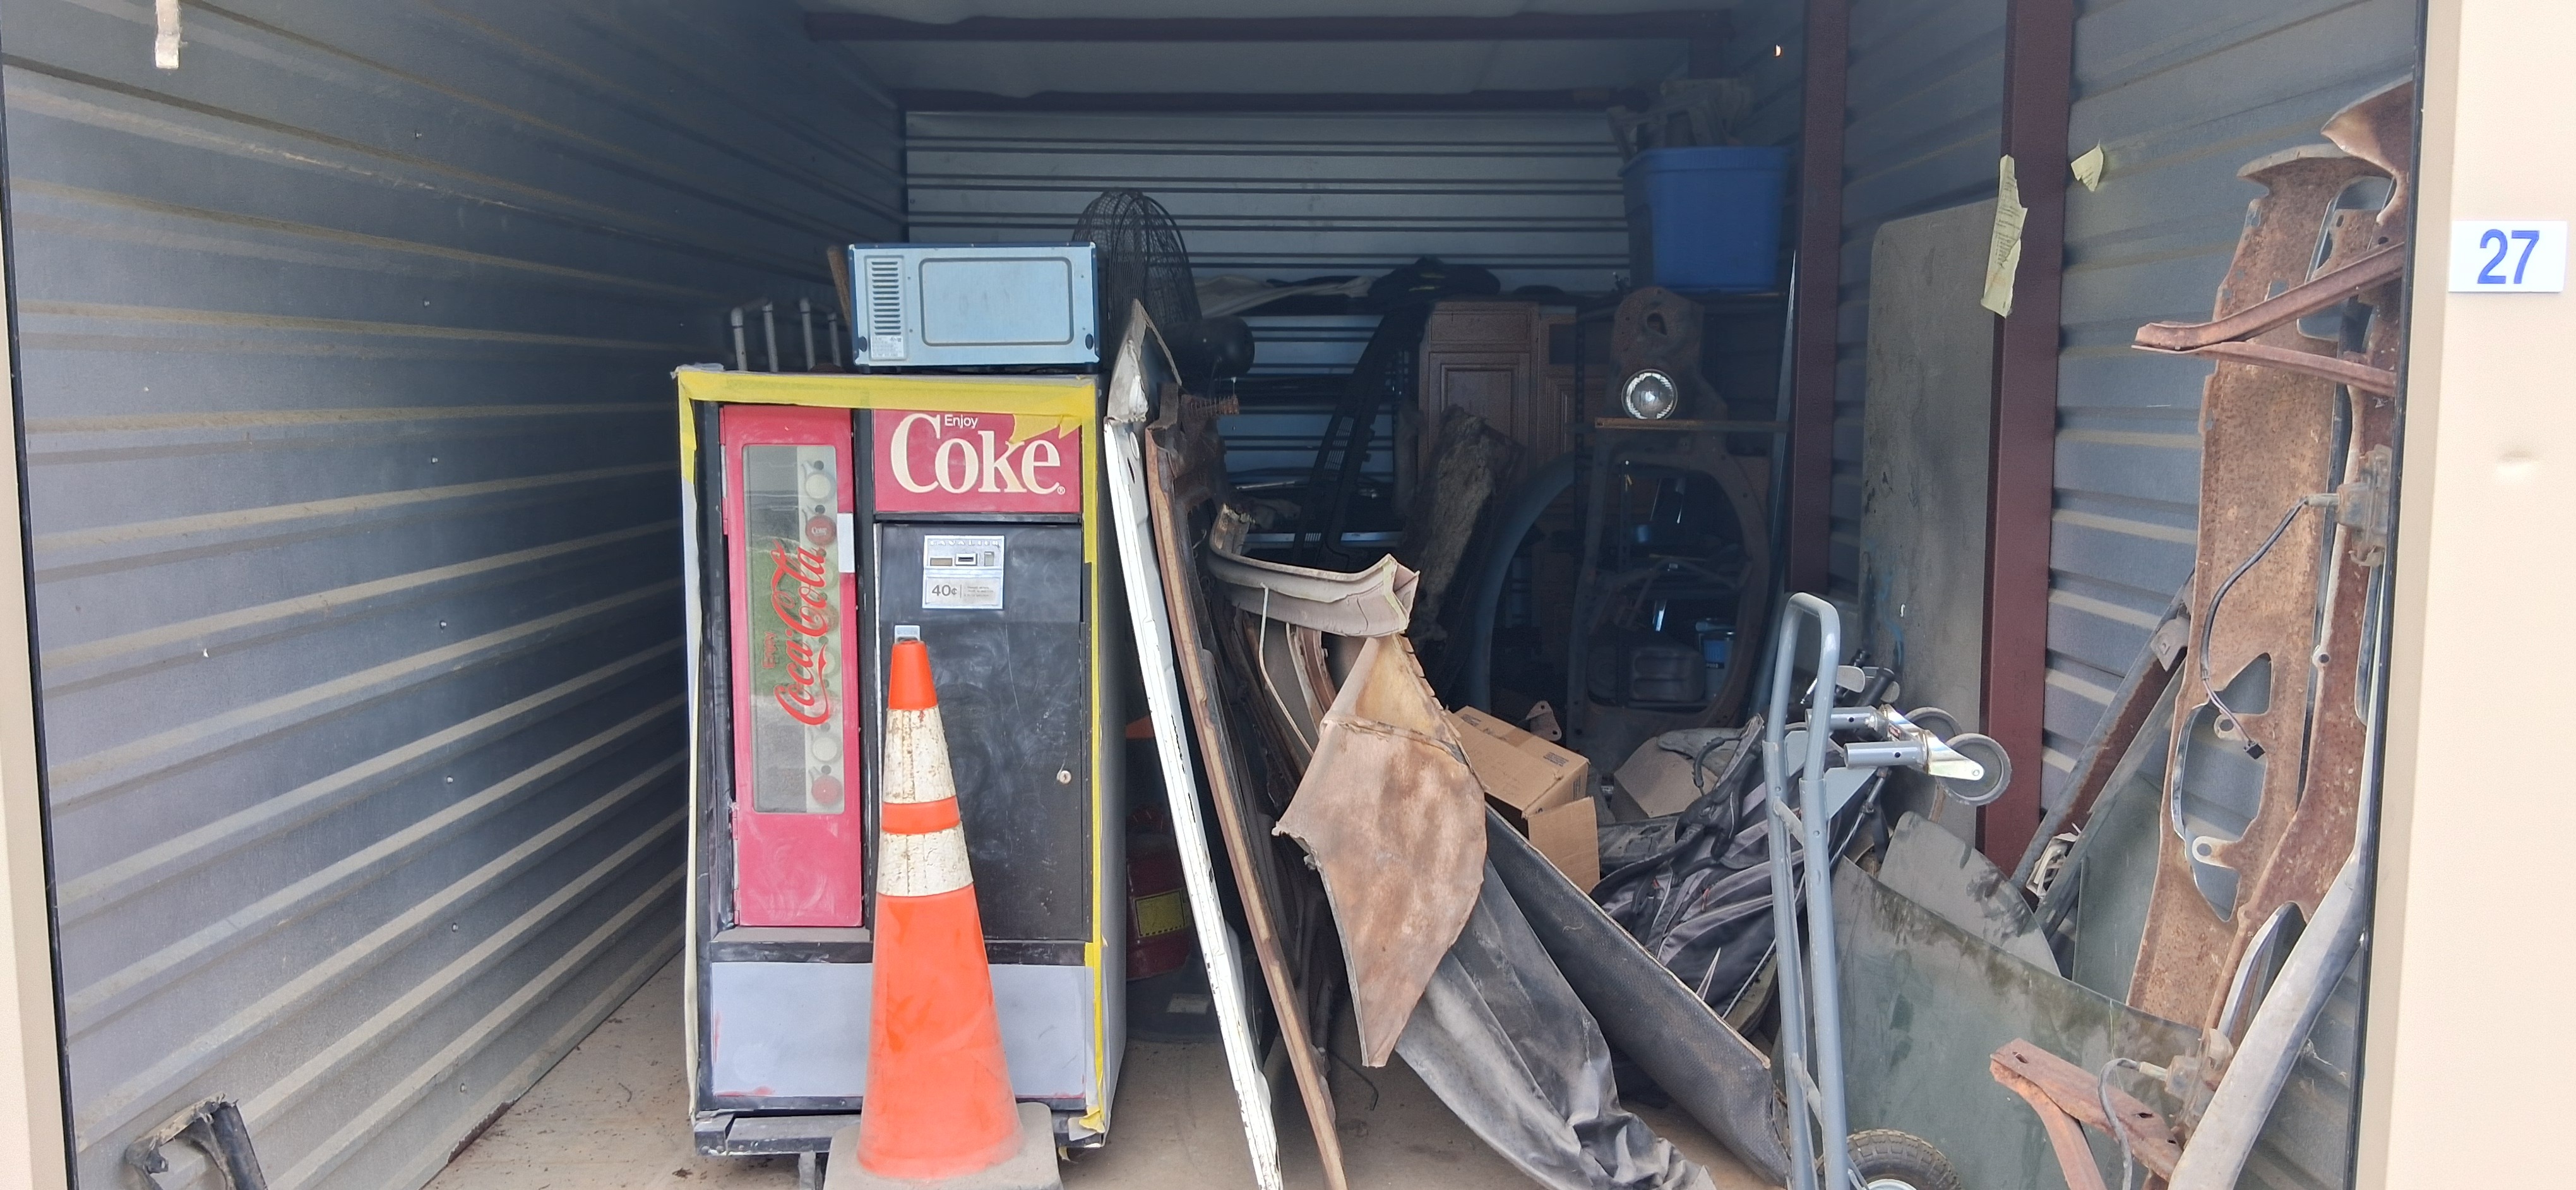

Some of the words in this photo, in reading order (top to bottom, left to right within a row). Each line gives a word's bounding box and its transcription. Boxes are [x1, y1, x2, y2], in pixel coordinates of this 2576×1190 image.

[2477, 229, 2539, 284] 27
[945, 414, 978, 429] Enjoy
[891, 413, 1061, 494] Coke
[931, 584, 958, 596] 40¢
[761, 631, 777, 669] Enjoy
